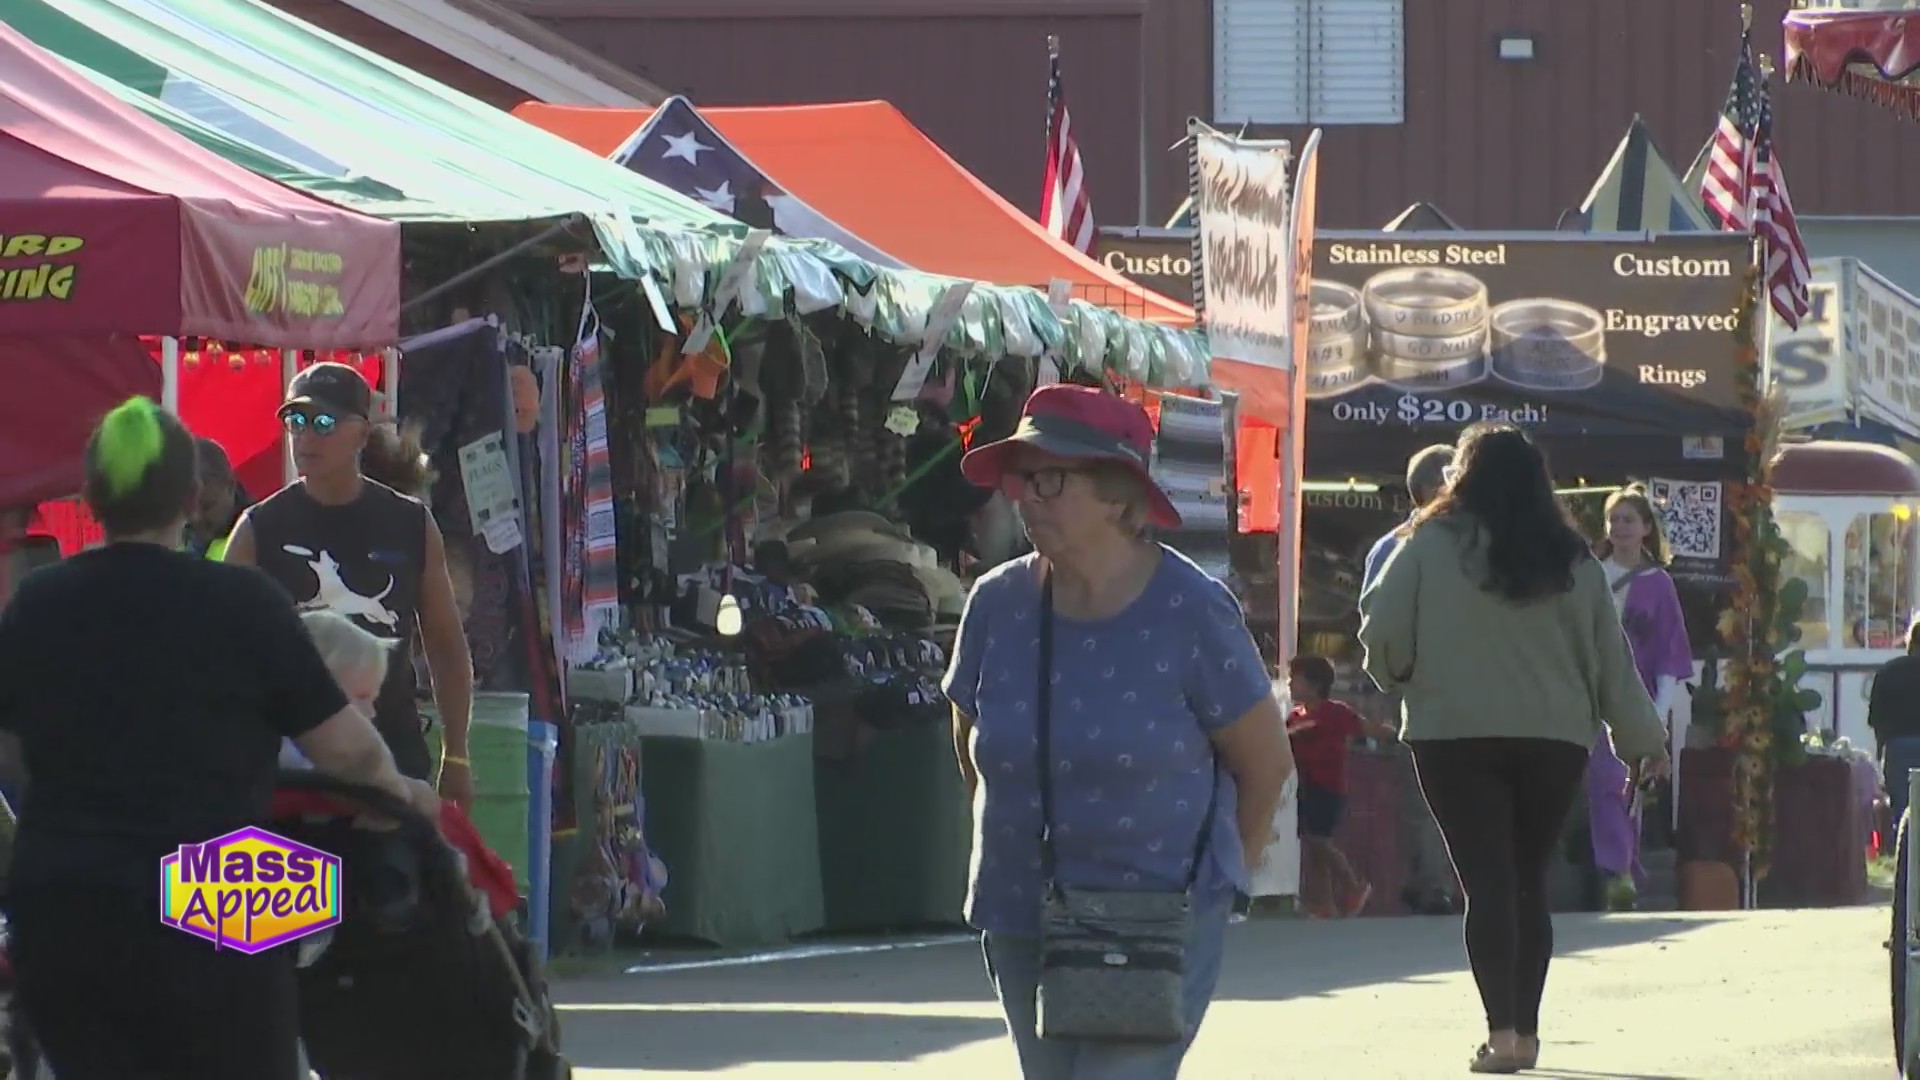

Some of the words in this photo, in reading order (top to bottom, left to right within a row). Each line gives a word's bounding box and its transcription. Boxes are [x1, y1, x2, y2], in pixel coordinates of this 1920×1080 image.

[0, 234, 84, 257] RD
[1329, 244, 1440, 265] Stainless
[1445, 244, 1506, 265] Steel
[1104, 250, 1192, 276] Custo
[1613, 253, 1732, 277] Custom
[0, 264, 75, 299] ING
[1605, 307, 1740, 338] Engraved
[1638, 364, 1708, 388] Rings
[1333, 402, 1390, 425] Only
[1397, 391, 1473, 425] $20
[1480, 403, 1549, 423] Each!
[1305, 492, 1383, 511] ustom
